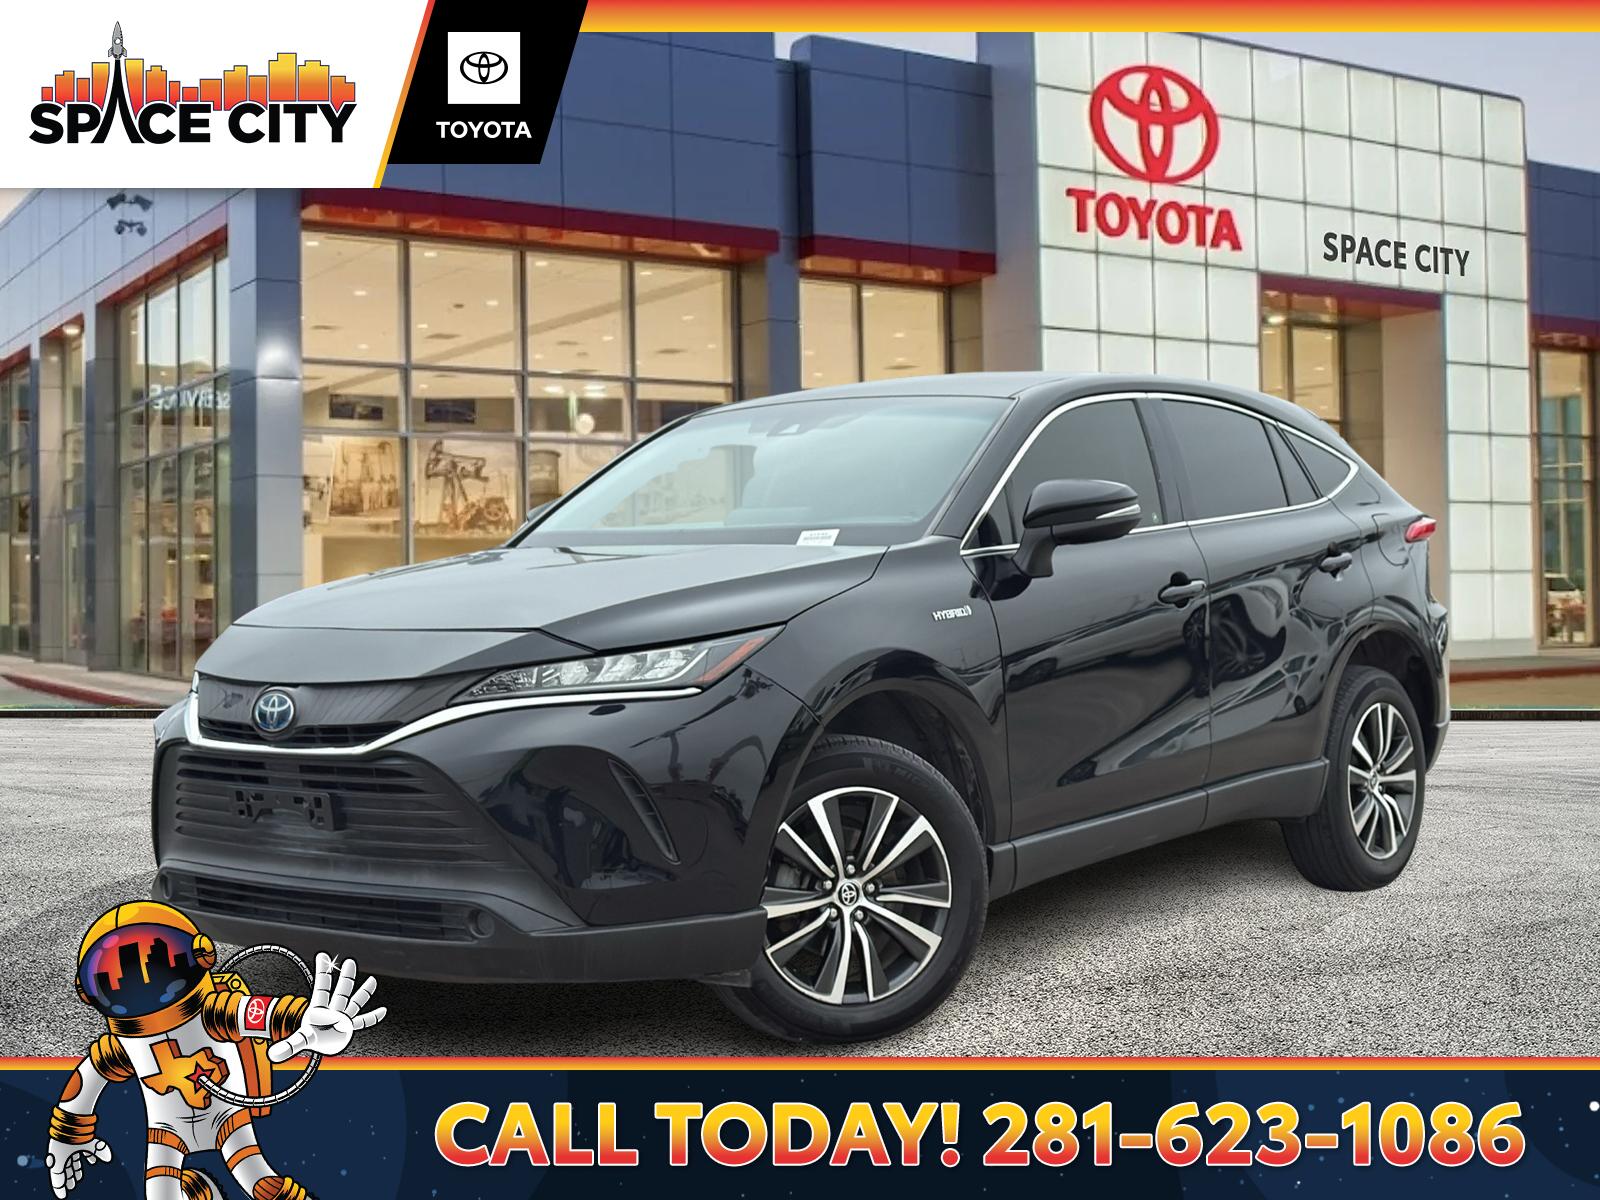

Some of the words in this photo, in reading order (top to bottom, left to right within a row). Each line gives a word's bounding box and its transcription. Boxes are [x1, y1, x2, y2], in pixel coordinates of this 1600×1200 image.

[1066, 188, 1242, 251] TOYOTA
[1322, 231, 1407, 270] SPACE
[1414, 244, 1471, 277] CITY
[932, 606, 969, 621] HYBRID
